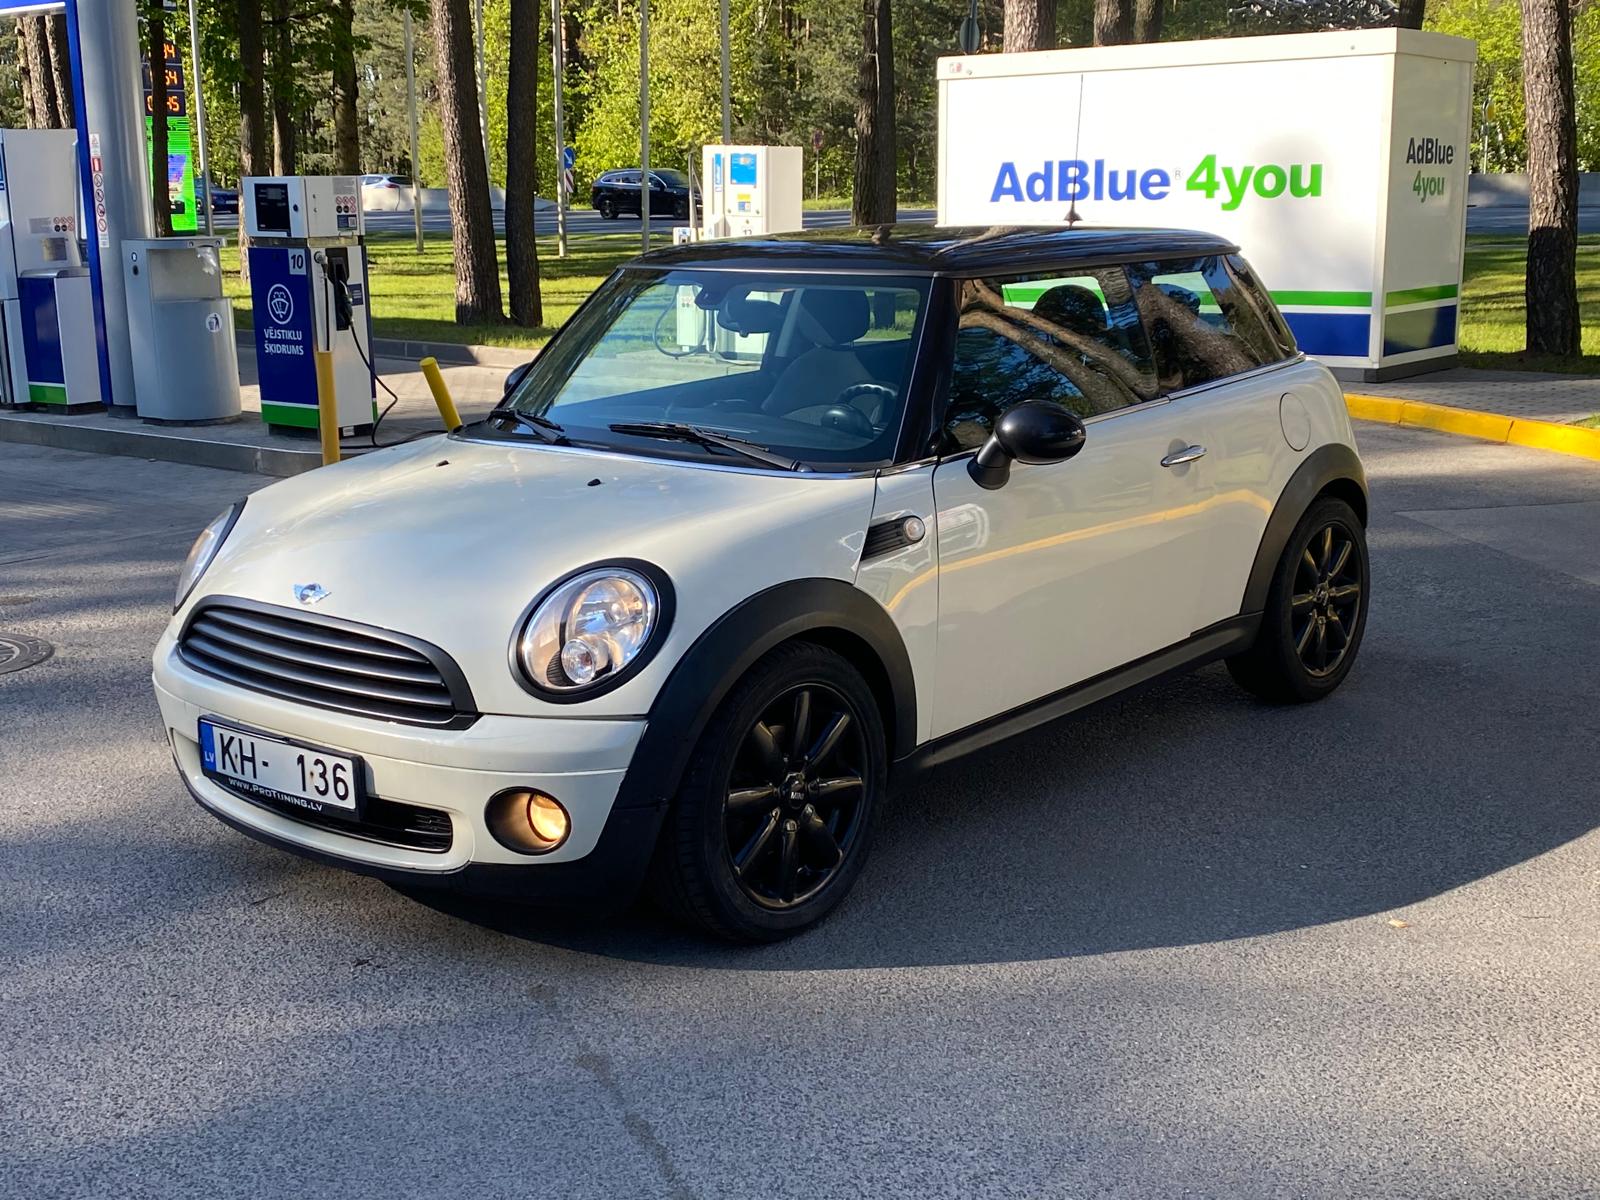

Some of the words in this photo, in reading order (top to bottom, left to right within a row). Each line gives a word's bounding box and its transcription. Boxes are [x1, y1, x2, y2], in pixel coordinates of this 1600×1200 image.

[1406, 137, 1454, 164] AdBlue
[1185, 153, 1323, 211] 4you
[1412, 170, 1445, 203] 4you
[291, 254, 304, 270] 10
[263, 326, 303, 341] VĒJSTIKLU
[204, 750, 215, 763] LV
[296, 753, 350, 801] 136
